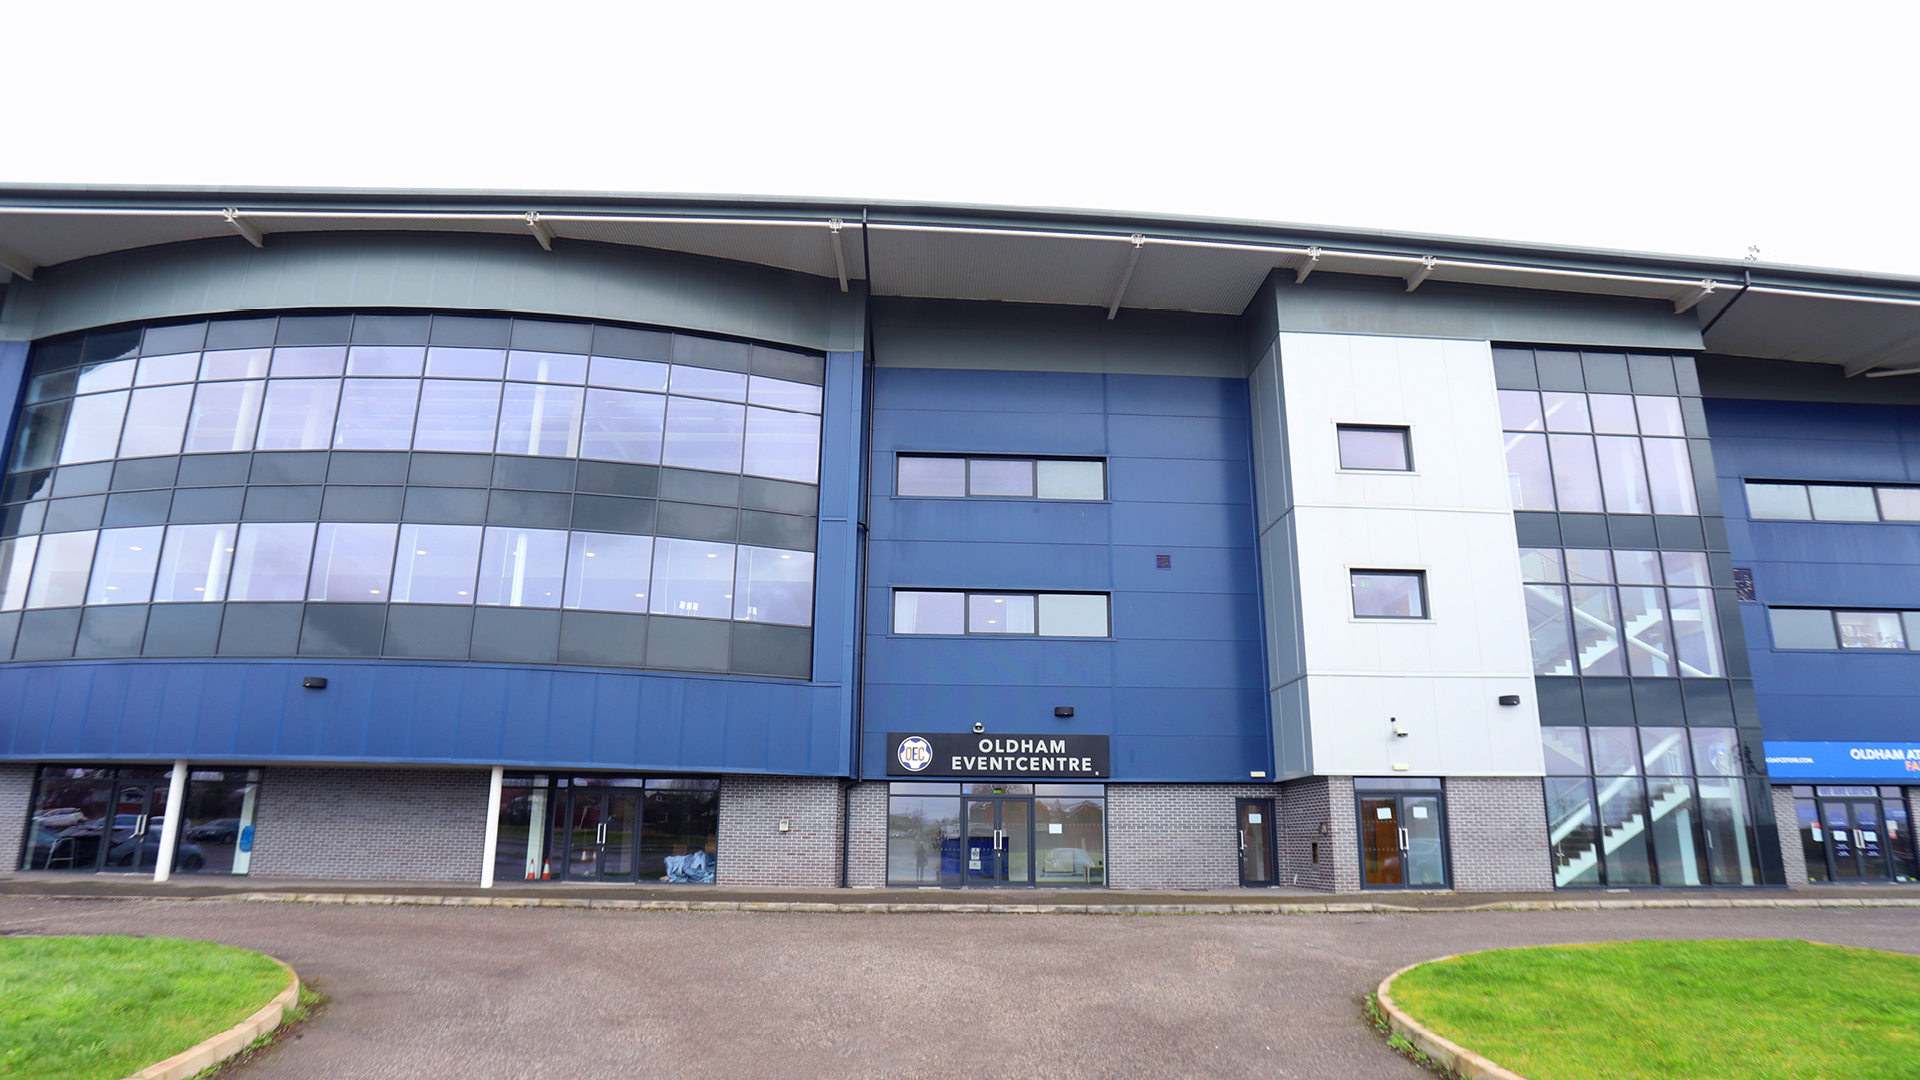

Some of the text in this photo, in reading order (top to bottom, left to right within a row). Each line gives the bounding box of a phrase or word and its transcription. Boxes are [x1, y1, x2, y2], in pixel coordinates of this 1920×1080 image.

[905, 746, 925, 761] OEC
[978, 738, 1066, 754] OLDHAM
[1850, 748, 1905, 760] OLDHAM
[951, 756, 1092, 772] EVENTCENTRE
[1905, 761, 1920, 772] FA
